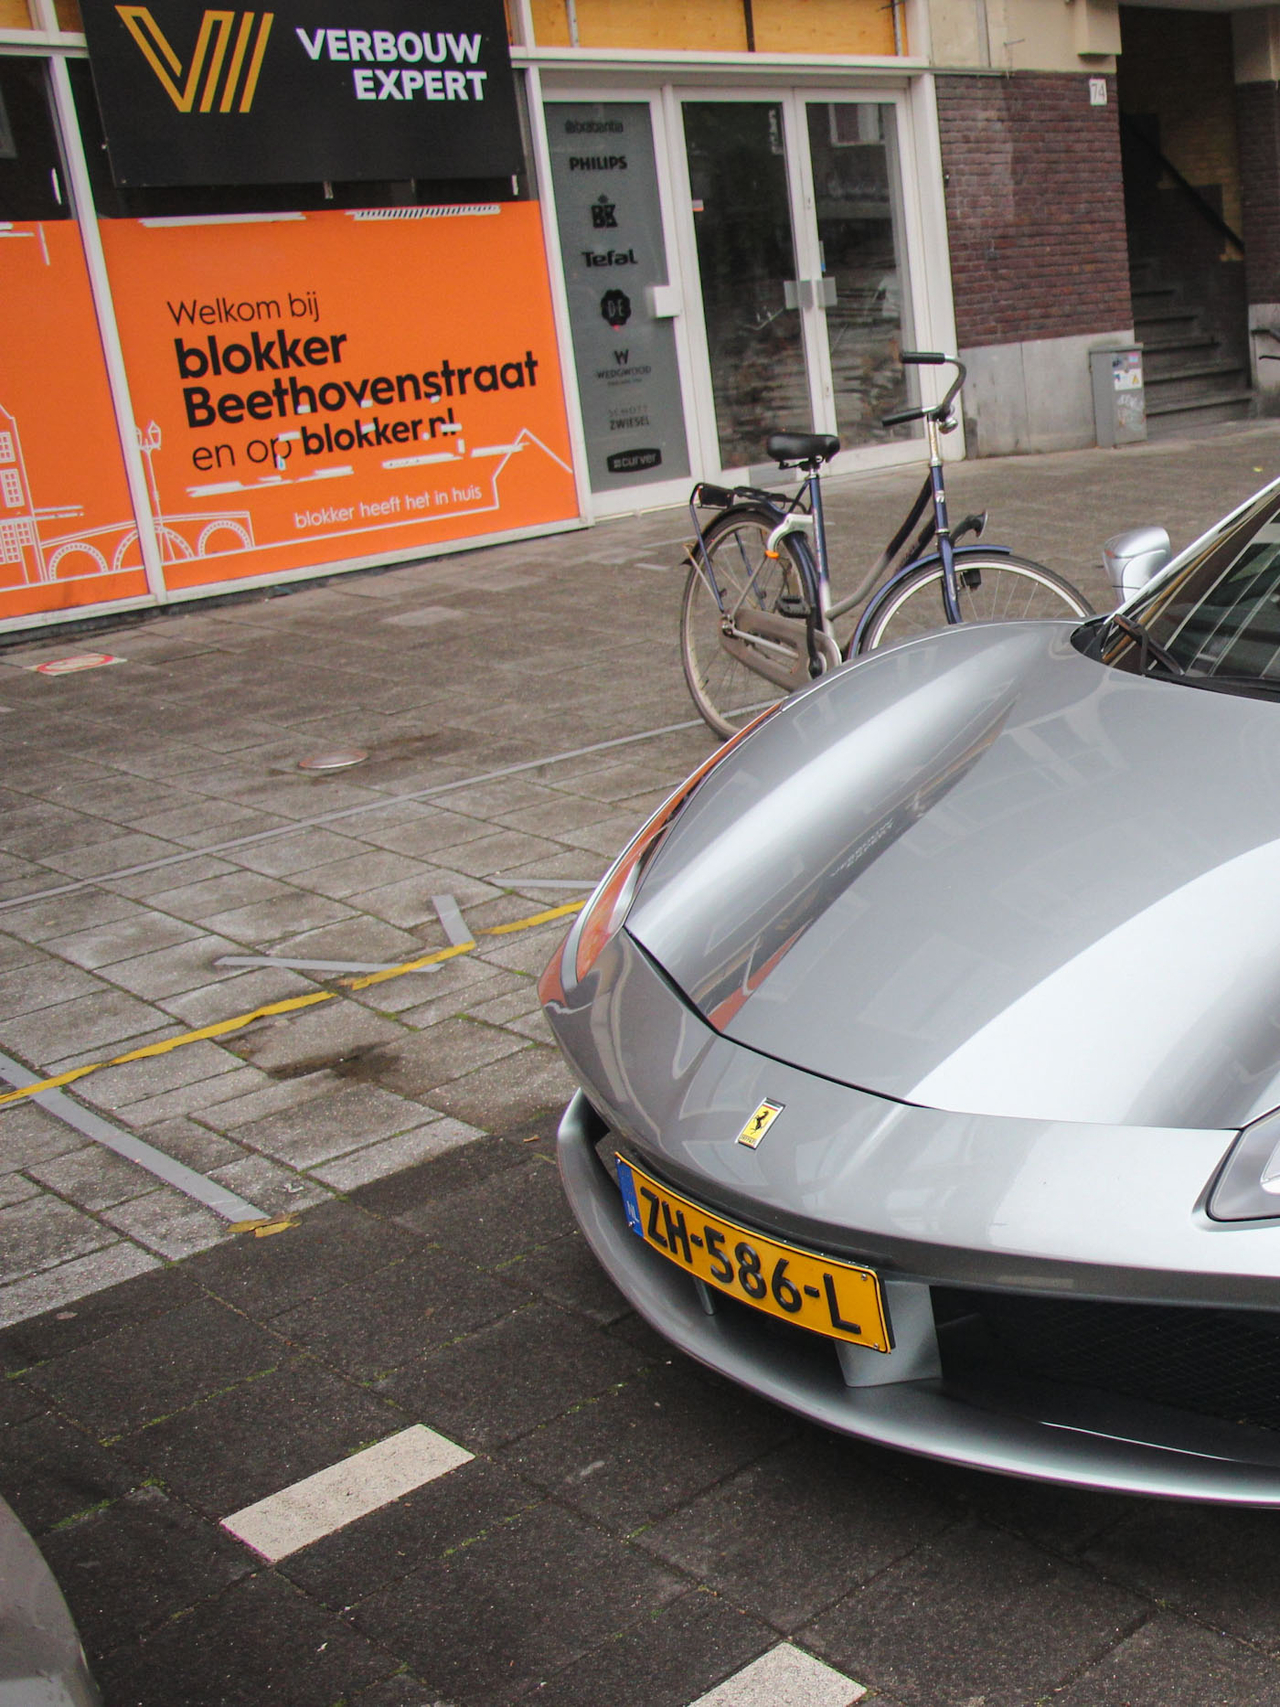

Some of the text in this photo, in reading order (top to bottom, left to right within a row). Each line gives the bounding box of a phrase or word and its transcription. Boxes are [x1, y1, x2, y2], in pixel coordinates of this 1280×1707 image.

[296, 28, 482, 64] VERBOUW
[353, 69, 487, 100] EXPERT
[1091, 82, 1106, 102] 74
[569, 156, 627, 171] PHILIPS
[581, 249, 638, 268] Tefal
[167, 291, 320, 326] Welkom bij
[174, 329, 347, 380] blokker
[596, 365, 652, 380] WEDGWOOD
[183, 351, 539, 428] Beethovenstraat
[193, 407, 458, 471] en op blokker.nl
[609, 416, 650, 431] ZWIESEL
[621, 453, 656, 469] curver
[294, 485, 483, 529] blokker heeft het in huis
[640, 1186, 861, 1335] ZH-586-L
